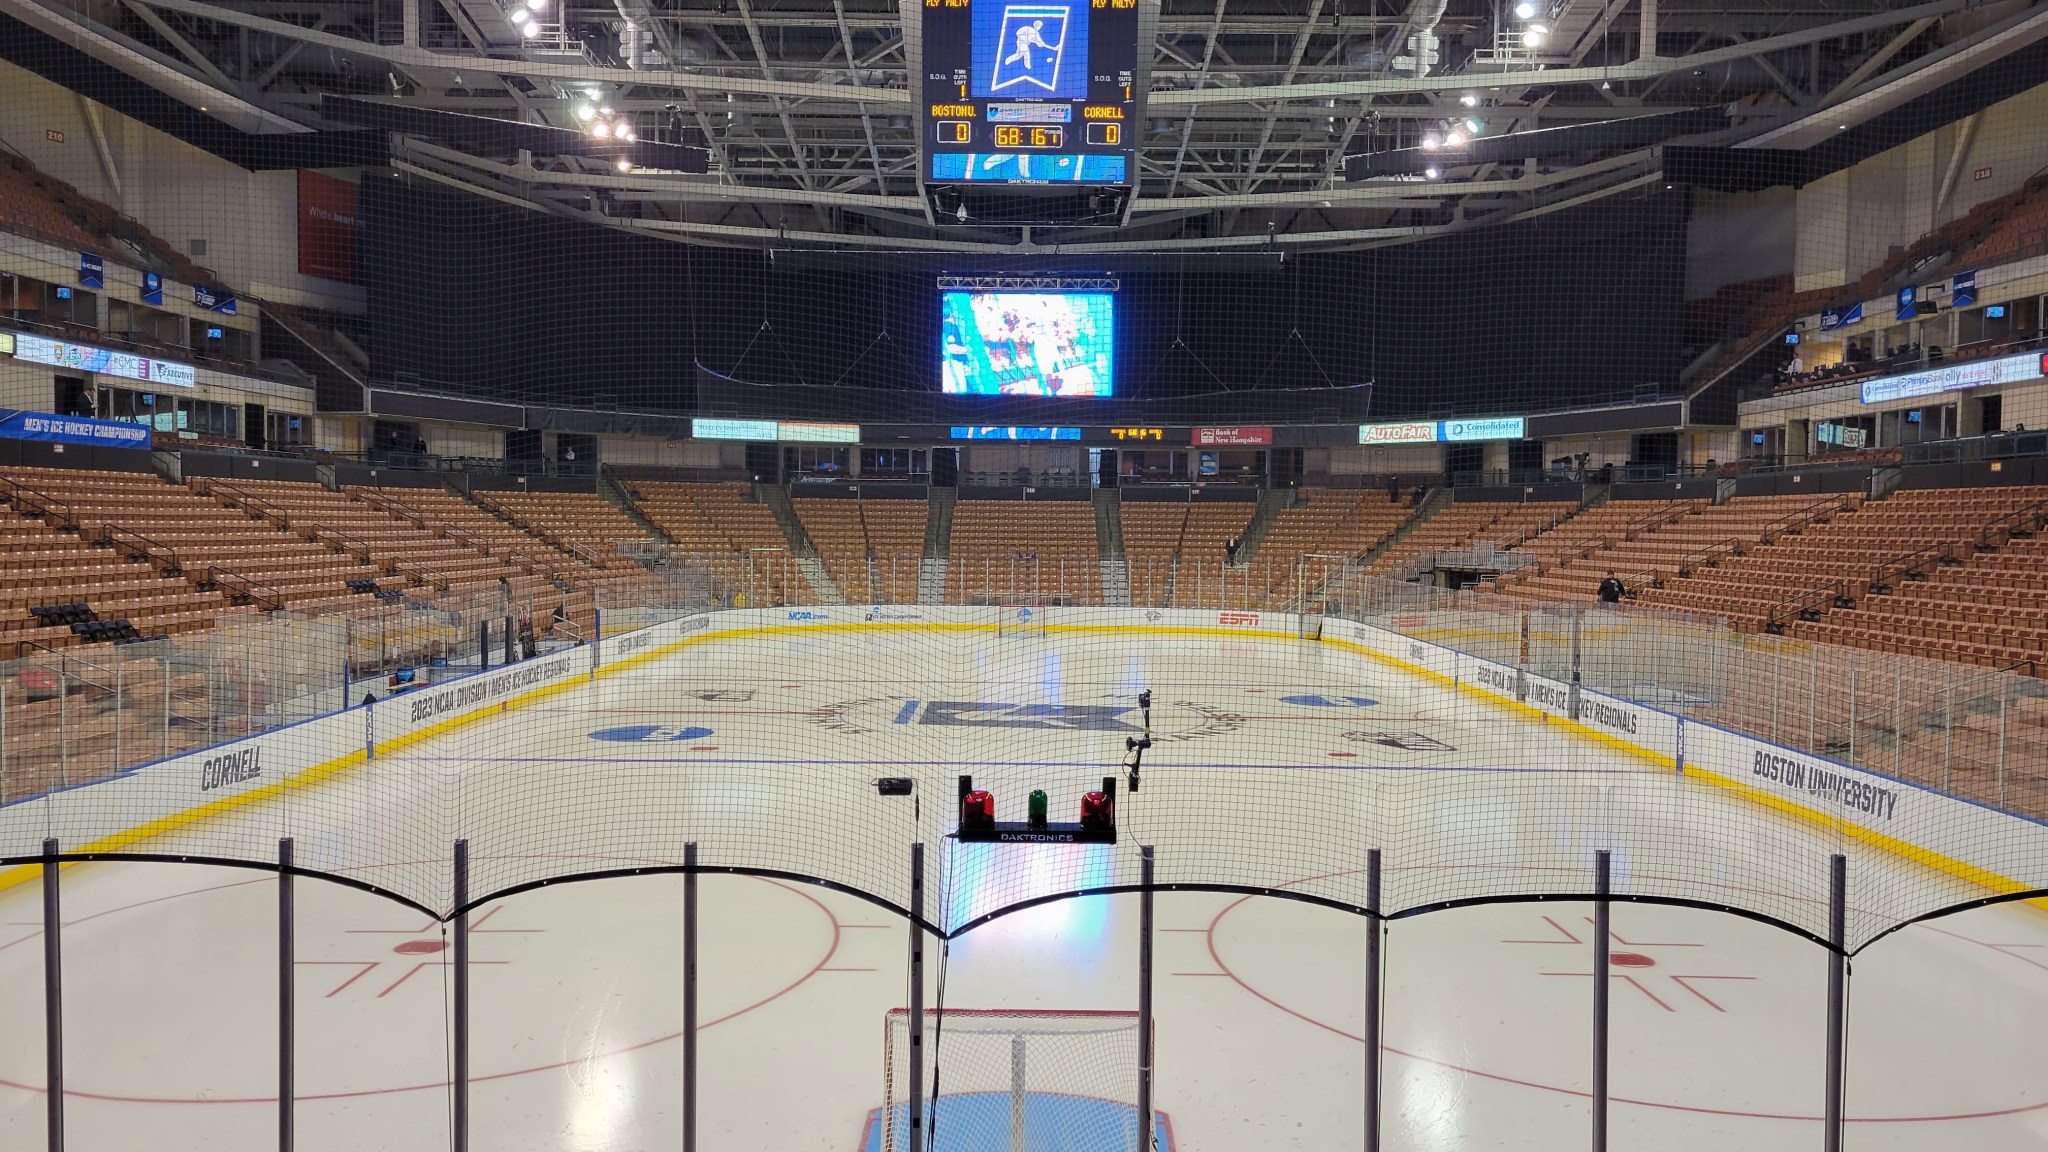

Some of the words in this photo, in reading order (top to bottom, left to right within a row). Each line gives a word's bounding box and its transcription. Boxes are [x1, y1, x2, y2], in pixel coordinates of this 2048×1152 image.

[1084, 107, 1124, 119] CORNELL
[48, 131, 63, 142] 210
[956, 123, 967, 141] 0
[1106, 125, 1117, 143] 0
[1975, 169, 1991, 179] 218
[1945, 368, 1961, 383] ally
[23, 418, 50, 433] MEN'S
[50, 420, 64, 433] ICE
[65, 423, 94, 436] HOCKEY
[94, 425, 146, 441] CHAMPIONSHIP
[1215, 428, 1230, 436] Bank
[1231, 428, 1238, 436] of
[1467, 421, 1520, 431] Consolidated
[1215, 436, 1229, 444] New
[1229, 436, 1262, 444] Hampshire
[787, 611, 830, 621] NCAA.com
[1219, 613, 1260, 626] ESPN
[411, 696, 433, 723] 2023
[434, 690, 454, 715] NCAA
[456, 681, 487, 708] DIVISION
[491, 674, 511, 697] MEN'S
[512, 670, 522, 691] ICE
[522, 663, 544, 687] HOCKEY
[543, 656, 571, 680] REGIONALS
[1477, 665, 1491, 685] 2023
[1490, 670, 1505, 690] NCAA
[1534, 683, 1555, 706] MEN'S
[1555, 689, 1567, 711] ICE
[1594, 702, 1637, 734] REGIONALS
[200, 745, 261, 791] CORNELL
[1753, 750, 1805, 789] BOSTON
[1807, 766, 1898, 821] UNIVERSITY
[1000, 833, 1074, 843] DAKTRONICS
